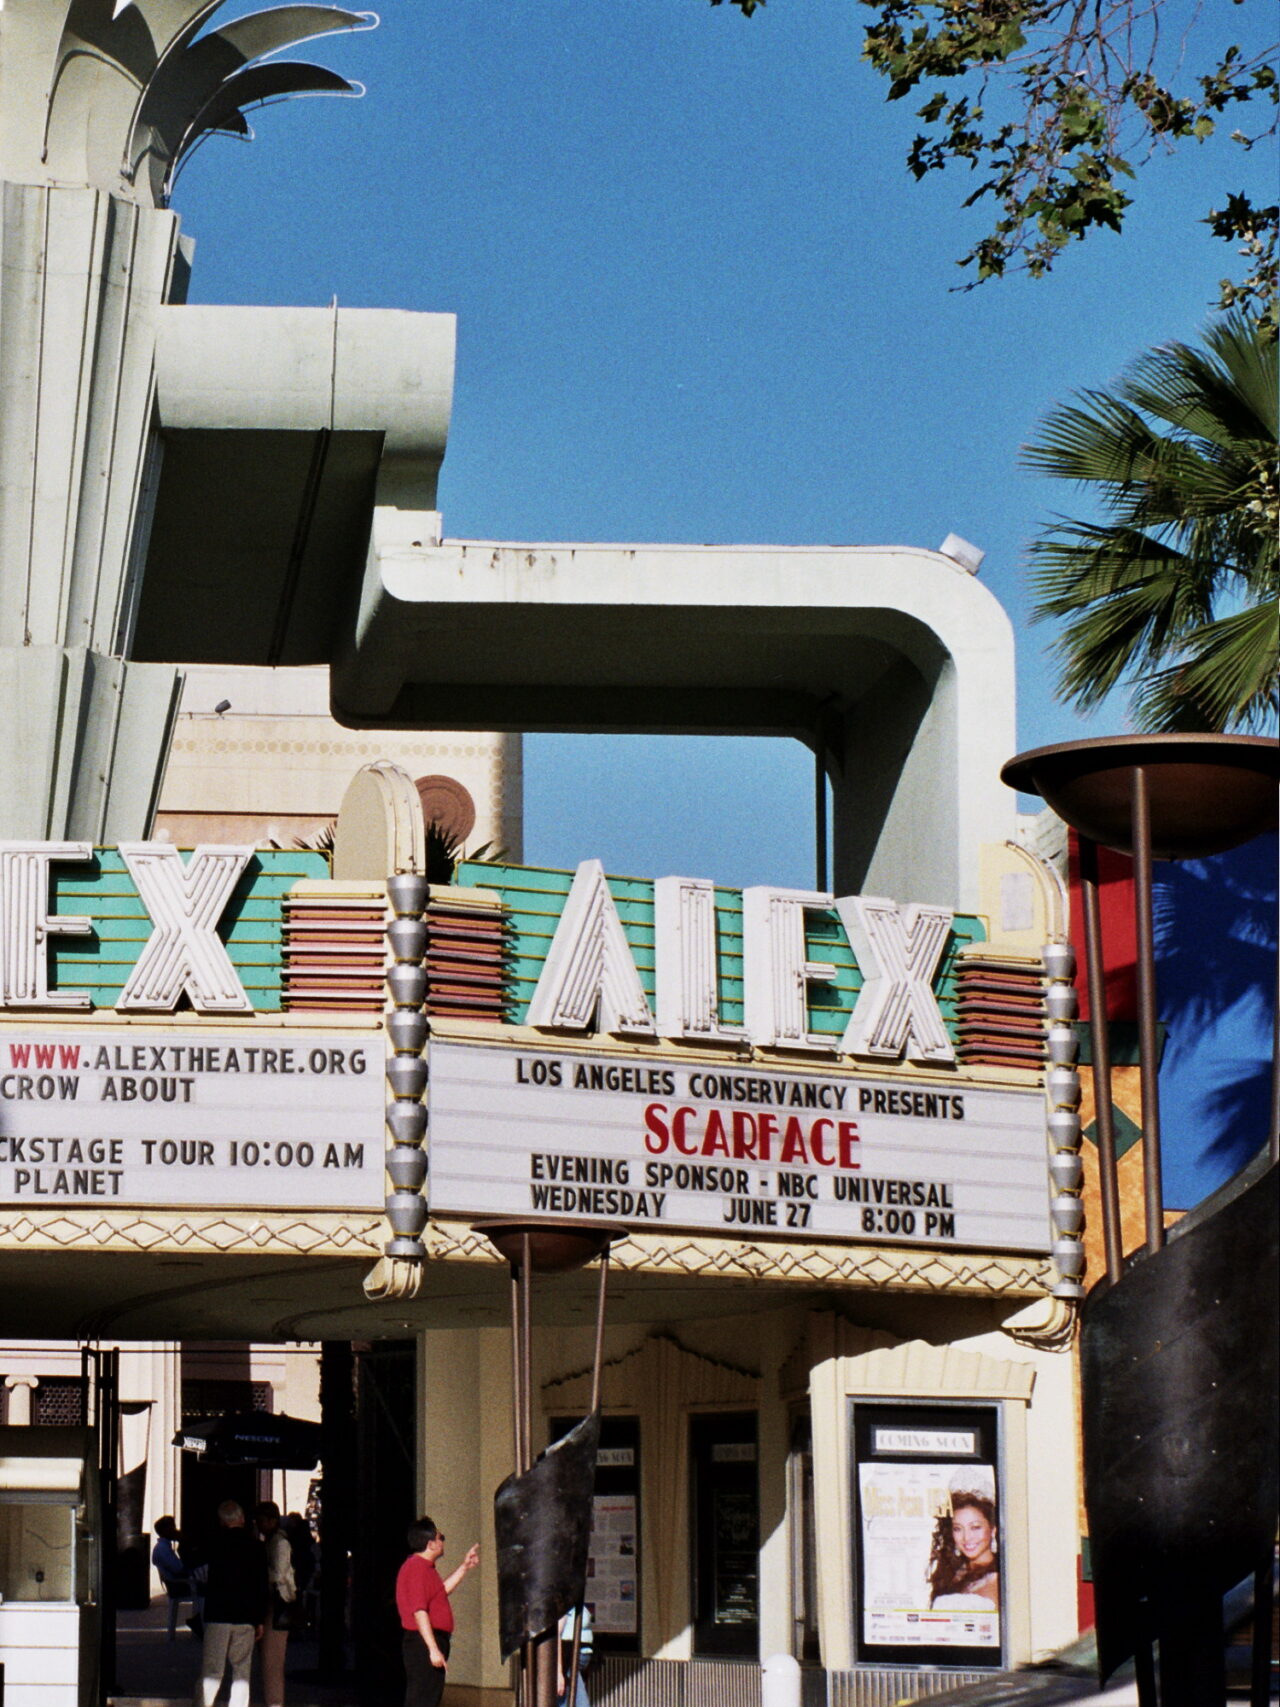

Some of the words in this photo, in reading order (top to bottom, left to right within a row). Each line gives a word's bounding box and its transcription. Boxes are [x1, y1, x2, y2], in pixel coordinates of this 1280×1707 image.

[525, 859, 956, 1062] ALEX
[9, 1044, 366, 1075] WWW.ALEXTHEATRE.ORG
[0, 1074, 79, 1101] CROW
[101, 1077, 195, 1103] ABOUT
[516, 1058, 562, 1086] LOS
[574, 1064, 675, 1096] ANGELES
[689, 1073, 847, 1111] CONSERVANCY
[859, 1087, 964, 1120] PRESENTS
[141, 1140, 215, 1167] TOUR
[230, 1141, 314, 1168] 10:00
[323, 1143, 364, 1169] AM
[644, 1102, 861, 1170] SCARFACE
[14, 1168, 124, 1195] PLANET
[530, 1153, 630, 1185] EVENING
[646, 1162, 749, 1195] SPONSOR
[777, 1172, 818, 1200] NBC
[833, 1176, 953, 1209] UNIVERSAL
[530, 1184, 666, 1218] WEDNESDAY
[723, 1199, 777, 1226] JUNE
[786, 1203, 811, 1228] 27
[861, 1207, 916, 1235] 8:00
[925, 1213, 955, 1238] PM
